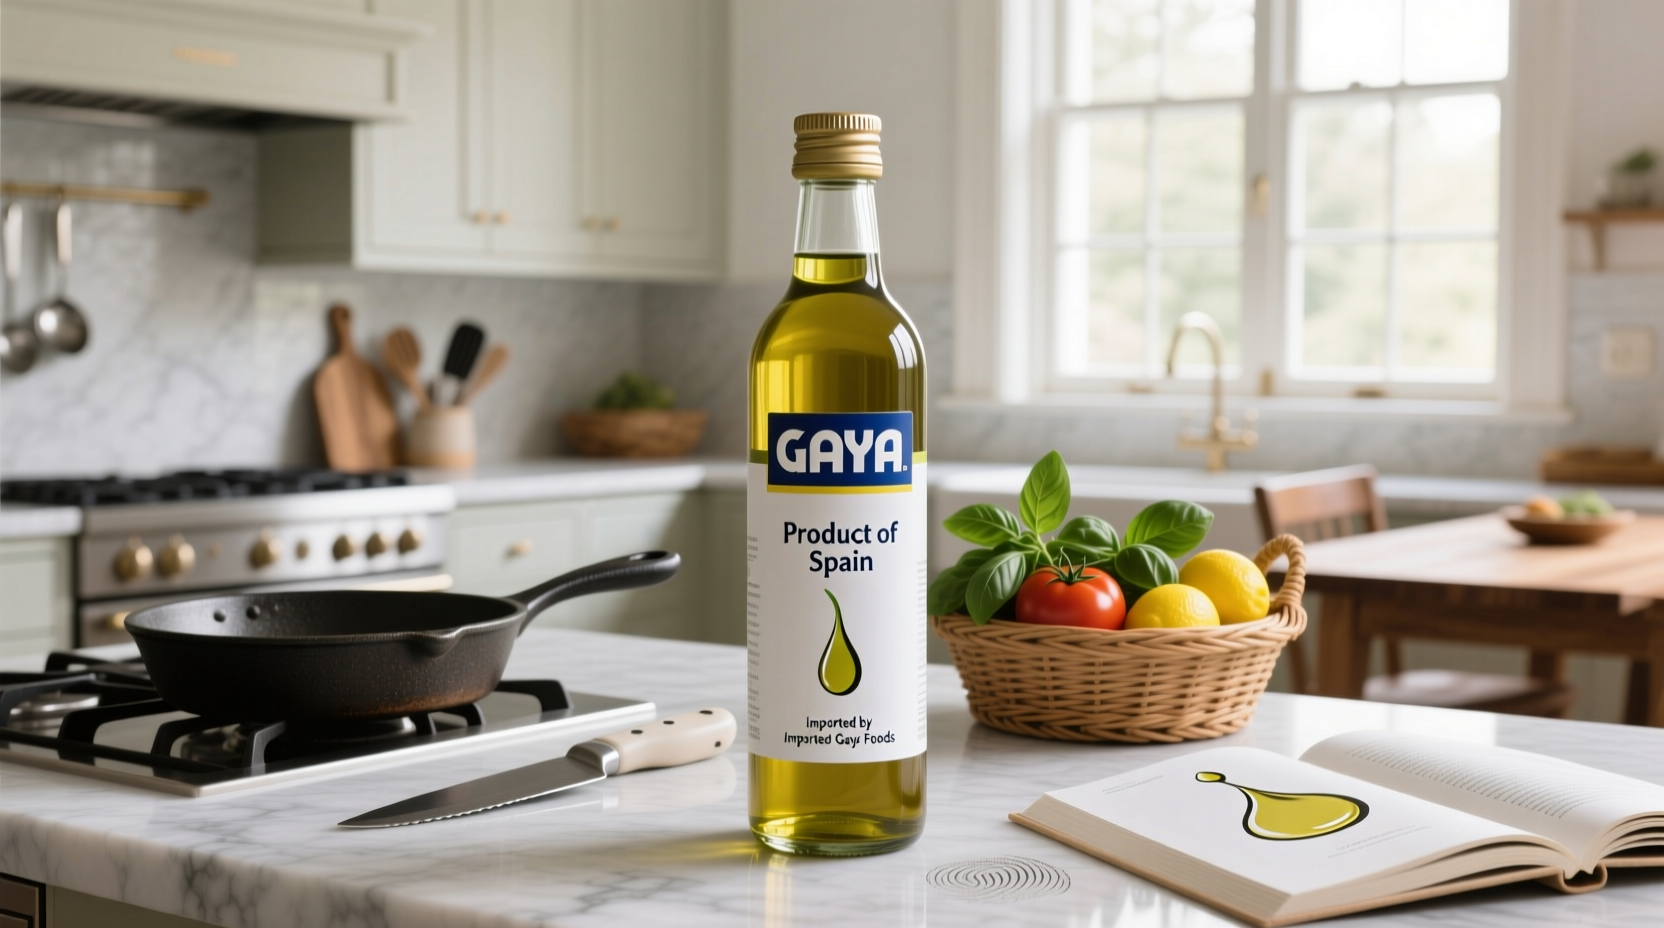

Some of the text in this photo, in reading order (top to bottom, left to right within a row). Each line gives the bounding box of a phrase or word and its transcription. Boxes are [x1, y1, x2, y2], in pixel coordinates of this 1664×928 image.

[776, 428, 903, 473] GAYA
[783, 520, 899, 544] Product of
[809, 550, 873, 578] Spain
[806, 715, 872, 731] Imported by
[864, 730, 896, 745] Foods
